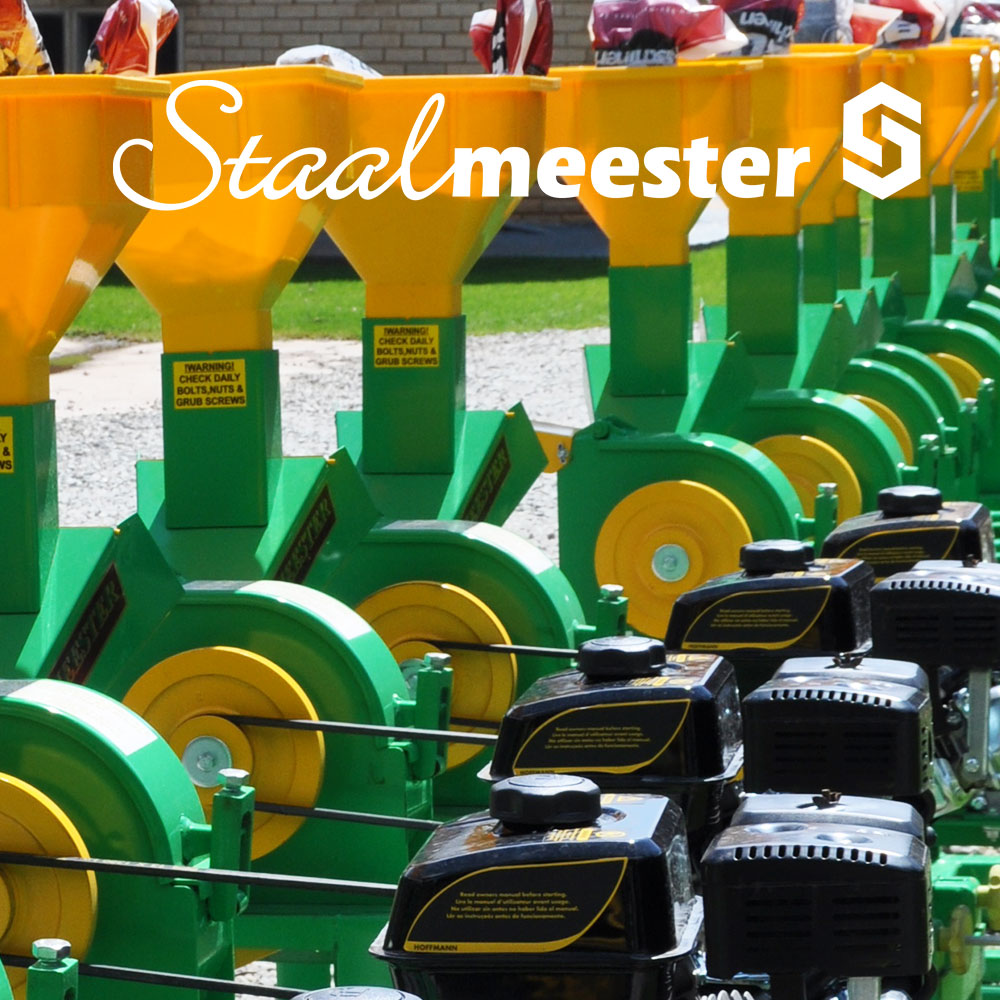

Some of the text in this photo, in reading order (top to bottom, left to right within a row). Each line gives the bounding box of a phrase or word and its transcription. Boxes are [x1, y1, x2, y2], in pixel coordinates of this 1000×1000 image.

[179, 373, 240, 383] CHECK DAILY
[176, 396, 245, 406] GRUB SCREWS
[2, 446, 10, 456] &
